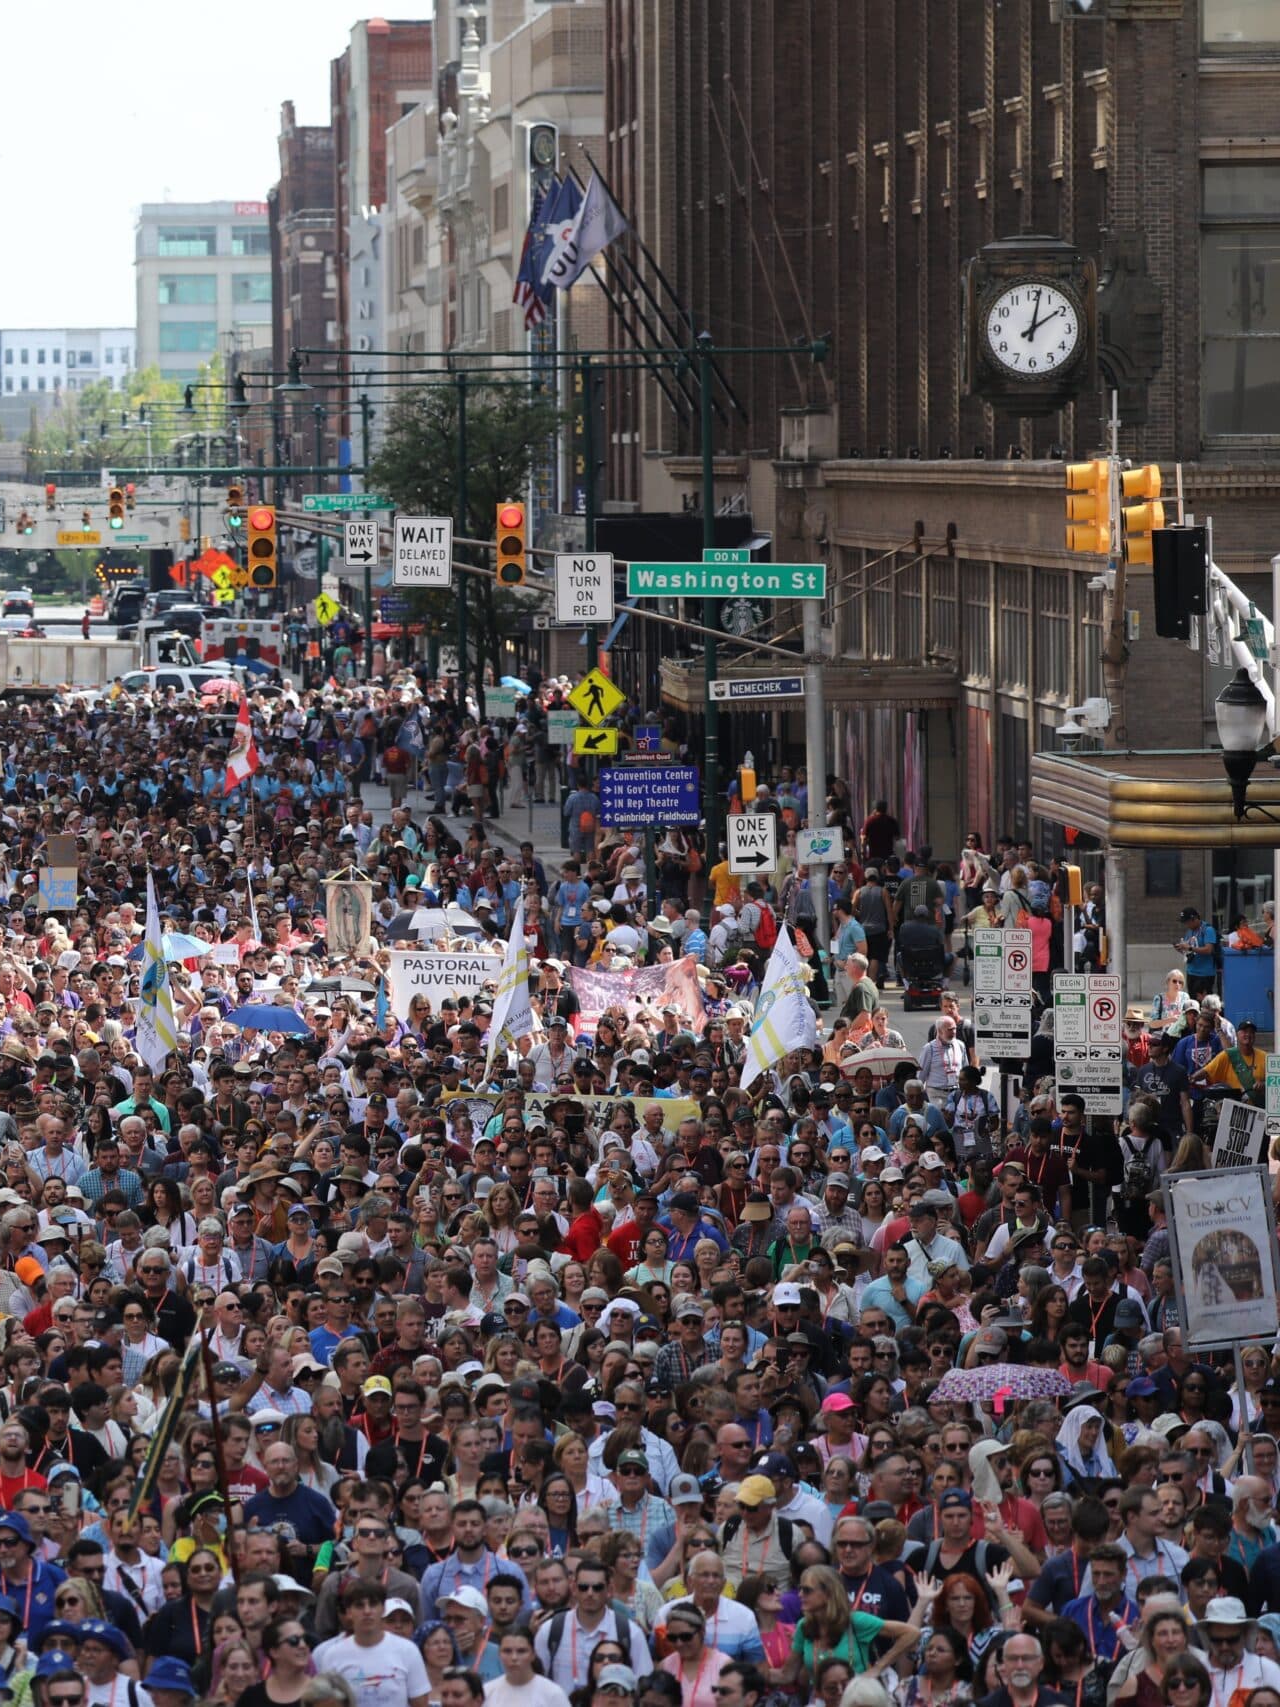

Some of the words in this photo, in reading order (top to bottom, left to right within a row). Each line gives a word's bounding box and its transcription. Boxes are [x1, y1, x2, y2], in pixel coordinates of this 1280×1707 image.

[349, 525, 374, 536] ONE
[402, 527, 445, 543] WAIT
[349, 537, 374, 548] WAY
[400, 549, 446, 561] DELAYED
[402, 565, 442, 577] SIGNAL
[573, 559, 596, 573] NO
[569, 576, 601, 588] TURN
[637, 570, 780, 593] Washington
[792, 572, 816, 590] St
[577, 590, 594, 602] ON
[573, 604, 598, 617] RED
[731, 682, 782, 695] NEMECHEK
[613, 770, 662, 781] Convention
[665, 769, 694, 780] Center
[614, 785, 624, 795] IN
[626, 784, 649, 795] Gov't
[651, 783, 681, 794] Center
[614, 798, 624, 809] IN
[627, 798, 643, 810] Rep
[646, 797, 679, 808] Theatre
[614, 812, 655, 824] Gainbridge
[658, 811, 698, 821] Fieldhouse
[736, 818, 767, 832] ONE
[737, 833, 768, 848] WAY
[982, 932, 996, 940] END
[1011, 933, 1025, 941] END
[403, 959, 491, 972] PASTORAL
[411, 973, 481, 986] JUVENIL
[1060, 979, 1081, 987] BEGIN
[1093, 979, 1115, 988] BEGIN
[1227, 1128, 1251, 1154] STOP
[862, 1592, 882, 1605] OF
